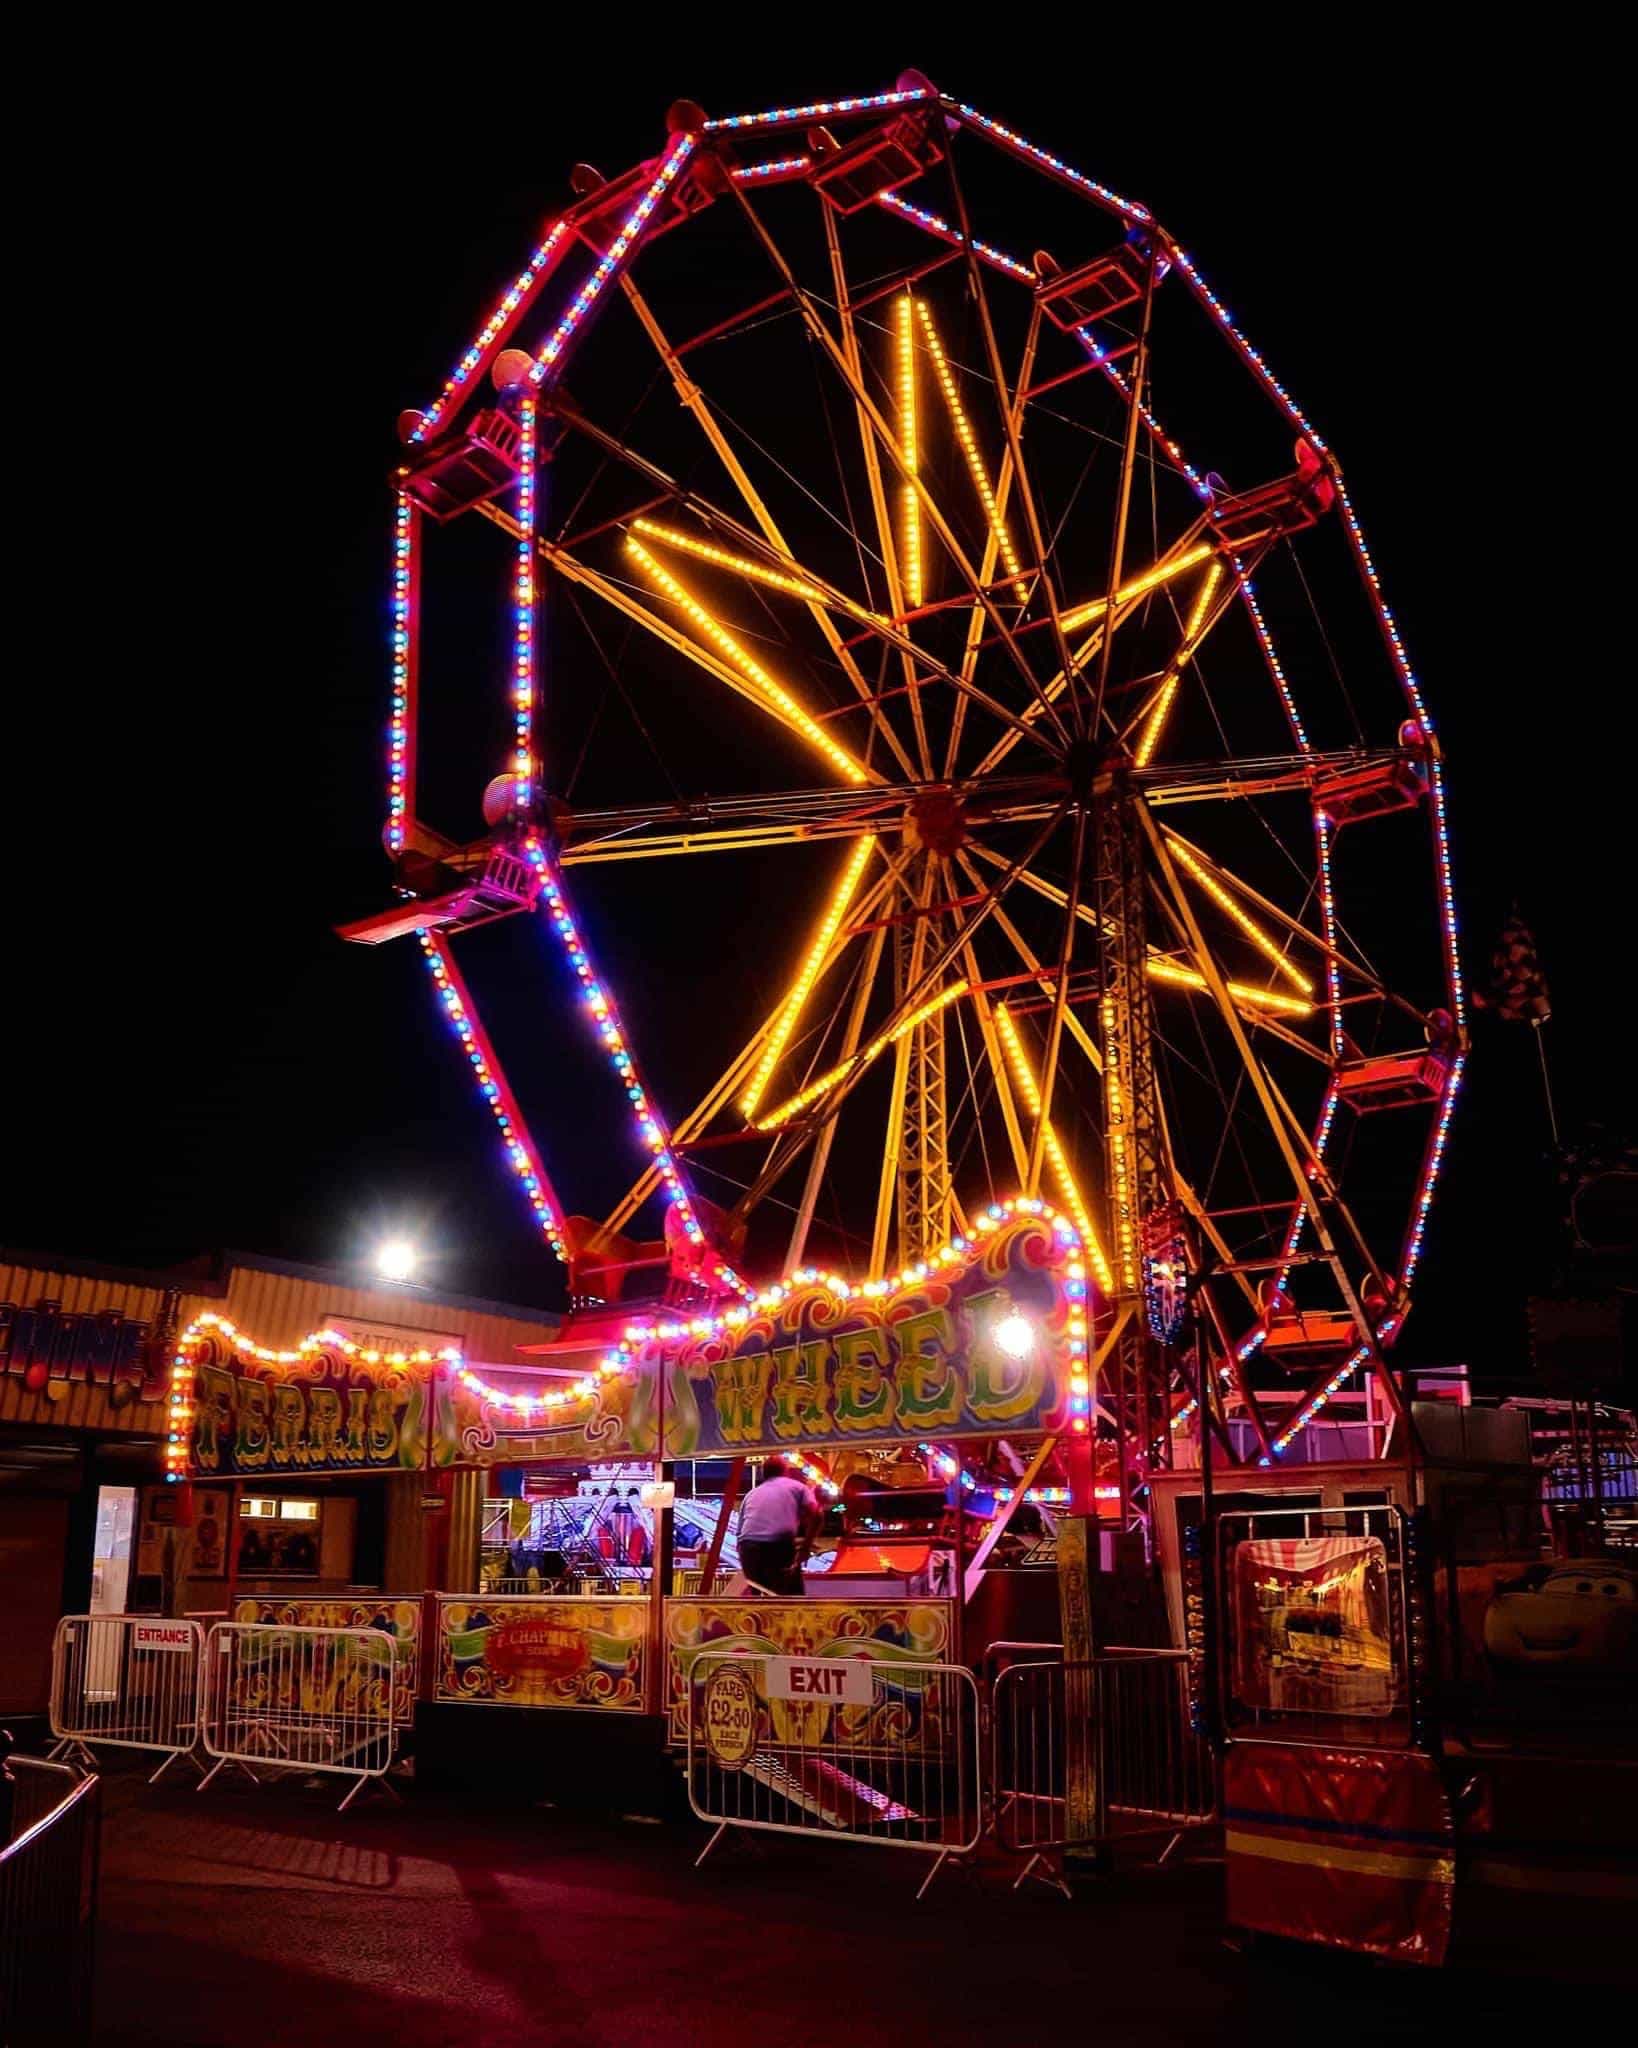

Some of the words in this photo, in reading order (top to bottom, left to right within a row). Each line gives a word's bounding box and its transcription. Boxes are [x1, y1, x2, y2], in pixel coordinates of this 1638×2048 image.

[196, 1364, 399, 1470] FERRIS
[709, 1287, 1048, 1444] WHEEL
[138, 1627, 189, 1644] ENTRANCE
[714, 1680, 745, 1701] FARE
[789, 1666, 847, 1695] EXIT
